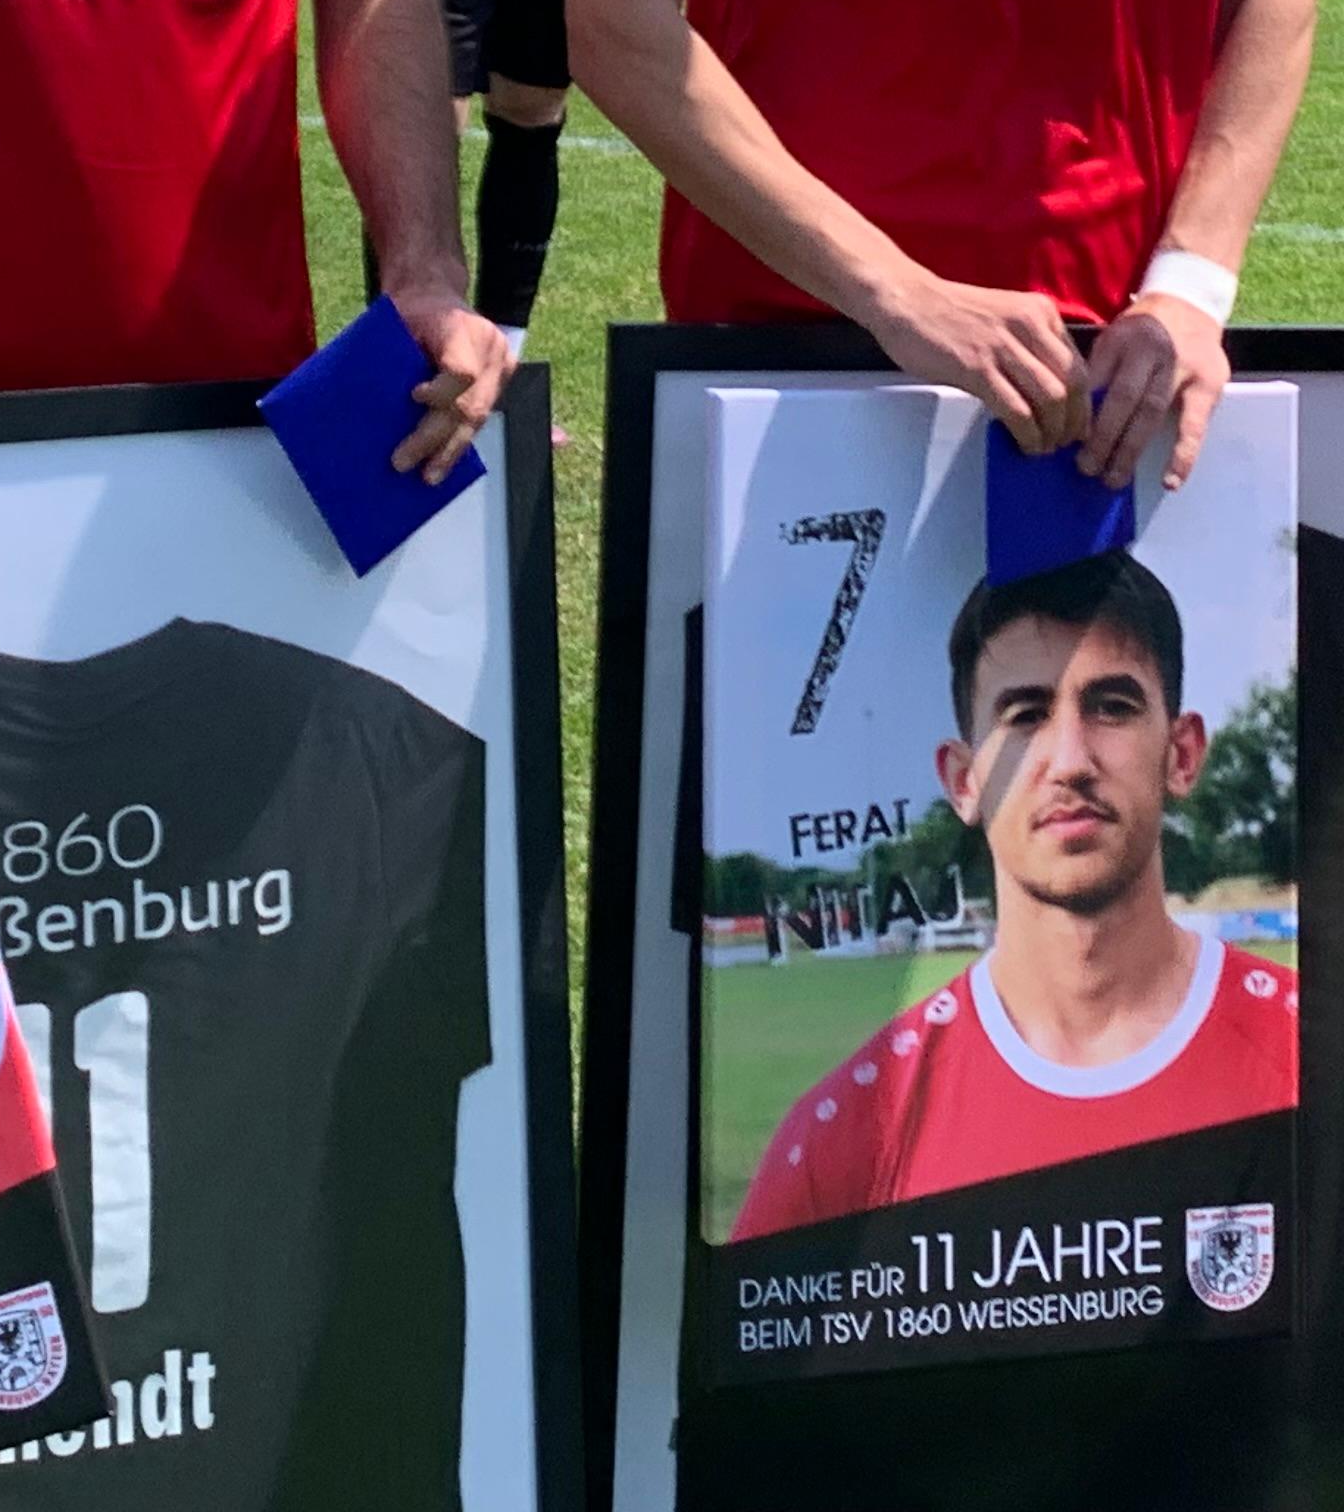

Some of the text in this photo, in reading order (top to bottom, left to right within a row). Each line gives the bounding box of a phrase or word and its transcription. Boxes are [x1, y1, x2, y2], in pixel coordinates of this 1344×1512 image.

[778, 506, 888, 736] 7
[788, 798, 911, 858] FERAT
[15, 990, 151, 1314] 1
[739, 1216, 1164, 1309] DANKE FÜR 11 JAHRE
[739, 1285, 1165, 1352] BEIM TSV 1860 WEISSENBURG
